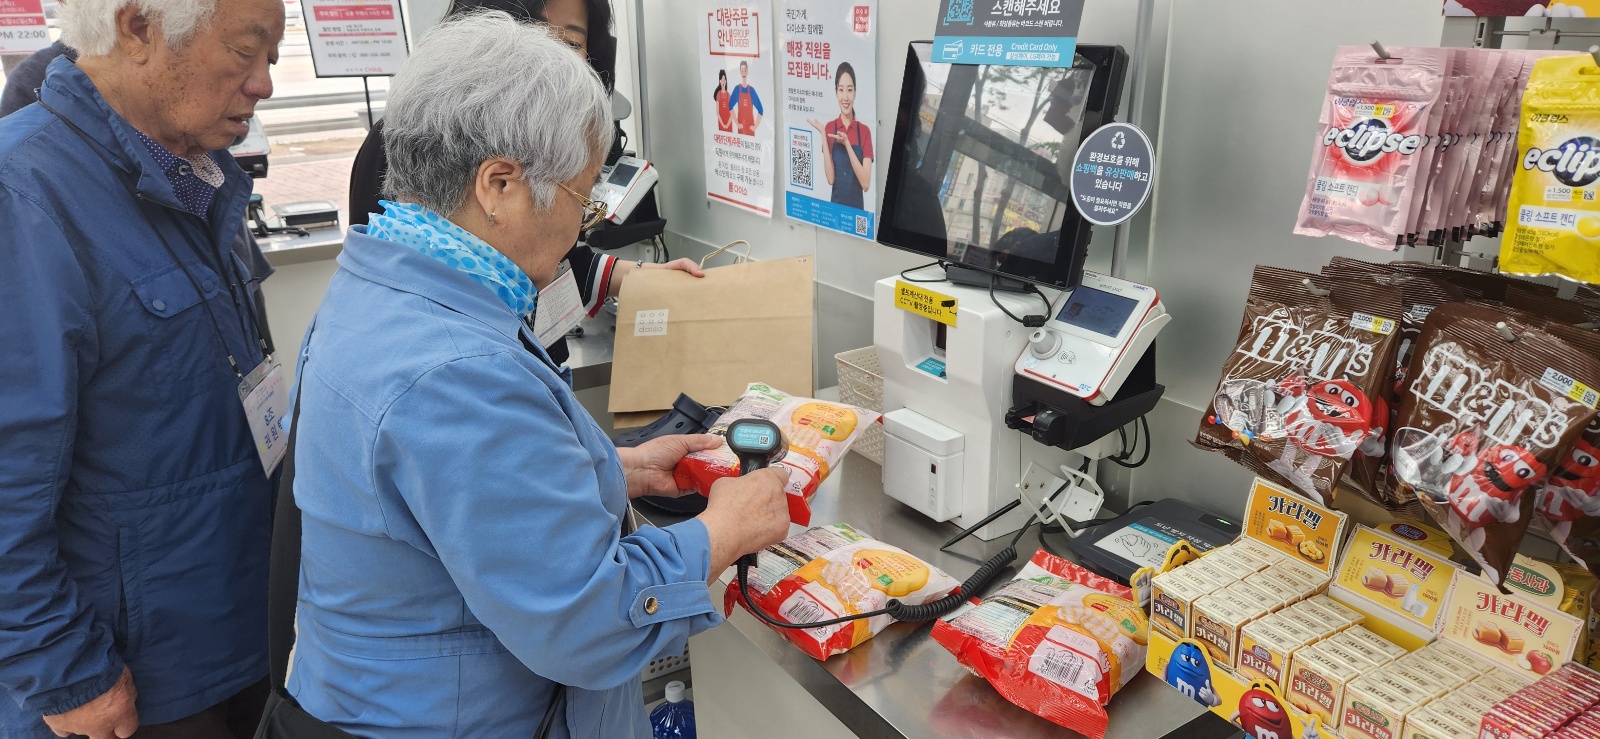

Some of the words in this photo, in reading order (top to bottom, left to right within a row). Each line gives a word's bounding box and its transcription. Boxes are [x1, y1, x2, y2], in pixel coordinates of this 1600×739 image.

[717, 8, 750, 27] 대량주문
[991, 0, 1061, 17] 스캔해주세요
[17, 30, 46, 39] 22:00
[718, 29, 733, 47] 안내
[734, 29, 749, 38] GROUP
[734, 39, 749, 48] ORDER
[787, 41, 803, 57] 매장
[805, 42, 832, 60] 직원을
[970, 44, 986, 56] 카드
[987, 43, 1004, 57] 전용
[1011, 42, 1028, 51] Credit
[1029, 43, 1043, 51] Card
[1044, 43, 1058, 53] Only
[788, 61, 832, 80] 모집합니다.
[1530, 113, 1570, 124] 이클립스
[1323, 126, 1422, 158] eclipse
[1089, 151, 1123, 166] 환경보호를
[1125, 156, 1140, 168] 위해
[1075, 163, 1104, 177] 쇼핑백을
[1105, 166, 1149, 182] 유상판매하고
[1094, 179, 1123, 192] 있습니다
[1328, 182, 1346, 193] 소프트
[1519, 208, 1534, 223] 쿨링
[1534, 210, 1558, 224] 소프트
[1560, 213, 1577, 228] 캔디
[900, 297, 912, 306] CCTV
[1267, 495, 1325, 534] 카라멜
[1369, 541, 1436, 583] 카라멜
[1154, 602, 1184, 628] 카라멜
[1475, 591, 1552, 639] 카라멜
[1196, 626, 1230, 653] 카라멜
[1243, 652, 1279, 682] 카라멜
[1176, 677, 1196, 701] m
[1294, 679, 1334, 710] 카라멜
